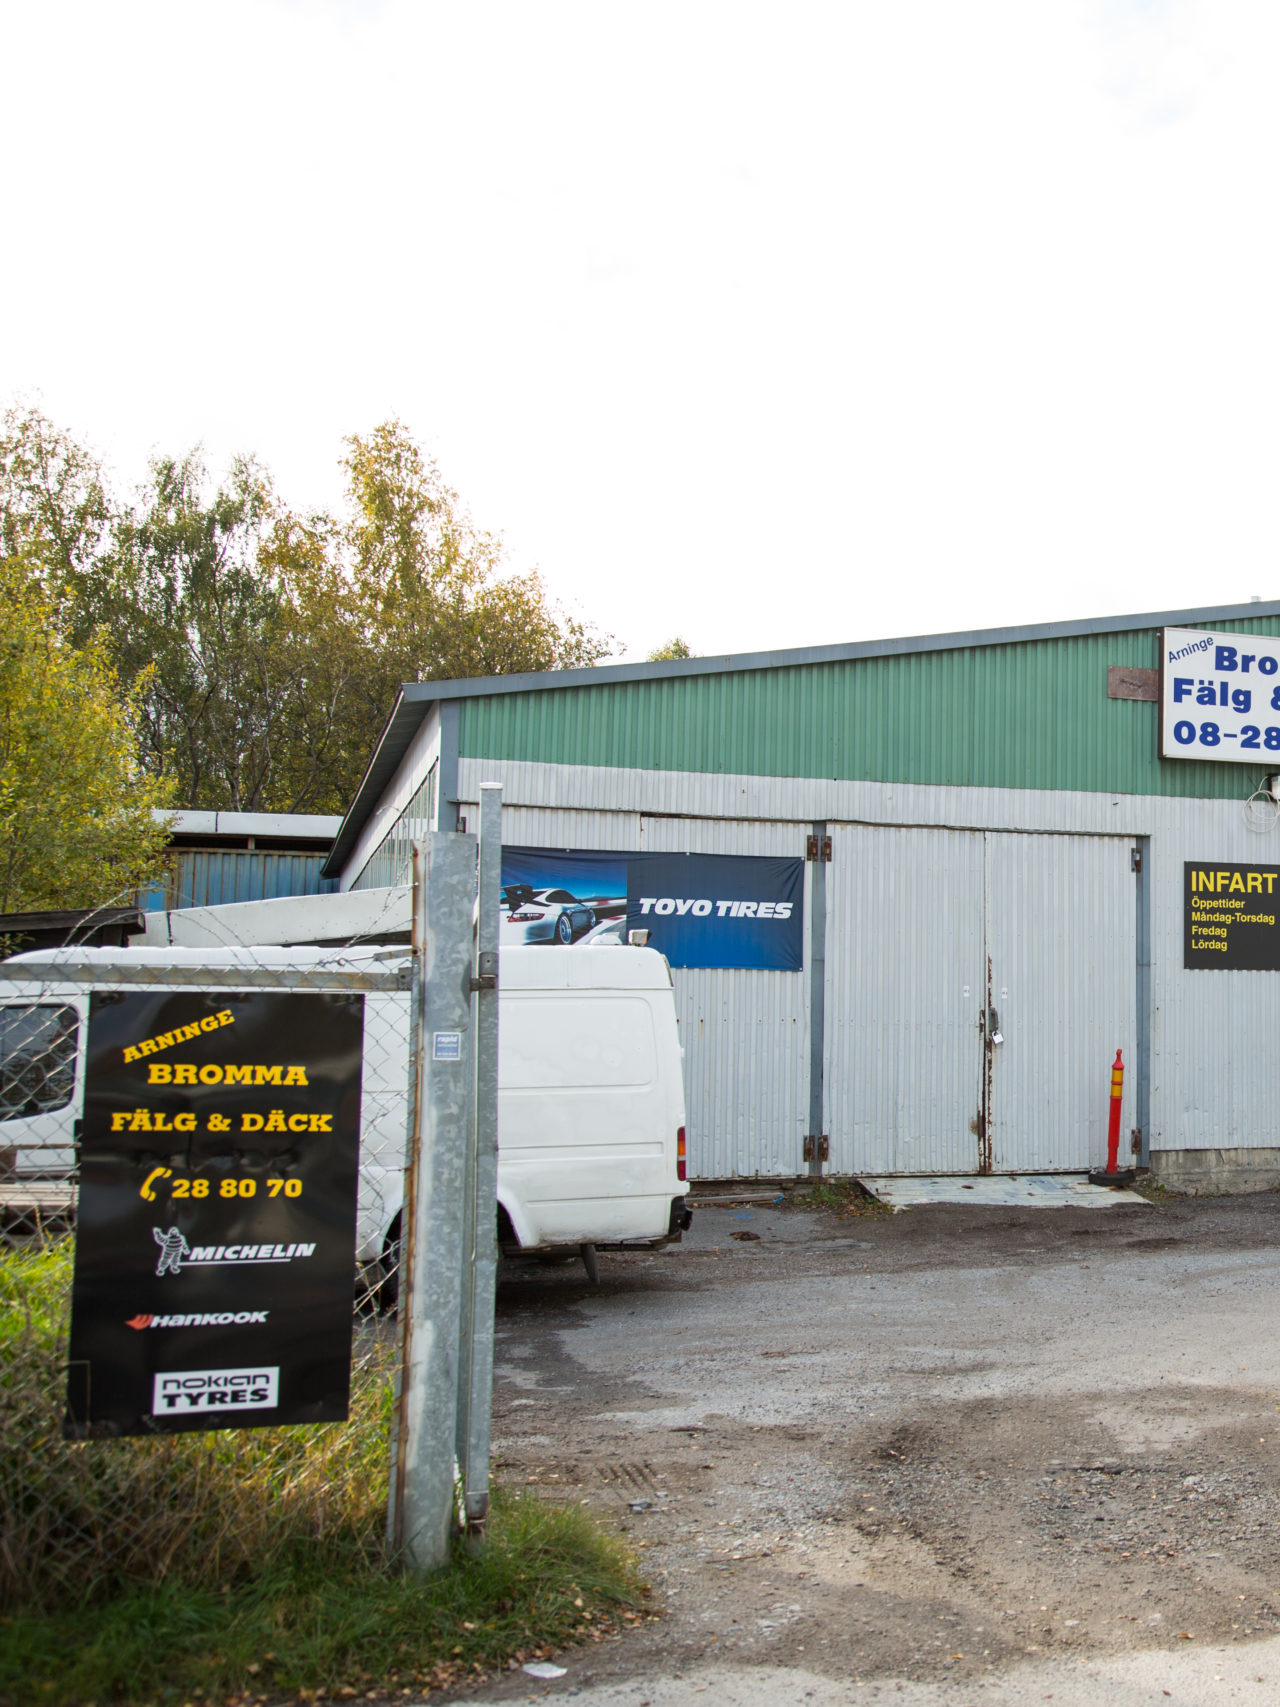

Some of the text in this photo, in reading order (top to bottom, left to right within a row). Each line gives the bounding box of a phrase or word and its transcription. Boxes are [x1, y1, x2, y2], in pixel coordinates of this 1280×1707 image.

[1168, 636, 1214, 664] Arninge
[1173, 677, 1252, 714] Fälg
[1191, 871, 1278, 893] INFART
[639, 898, 793, 919] TOYO TIRES
[1191, 896, 1245, 910] Öppettider
[1191, 912, 1275, 925] Måndag-Torsdag
[1191, 925, 1227, 938] Fredag
[1191, 939, 1228, 951] Lördag
[123, 1009, 235, 1064] ARNINGE
[147, 1064, 309, 1087] BROMMA
[110, 1110, 333, 1133] FÄLG & DÄCK
[171, 1178, 302, 1199] 28 80 70
[189, 1242, 316, 1261] MICHELIN
[162, 1374, 270, 1390] nokian
[162, 1388, 269, 1409] TYRES
